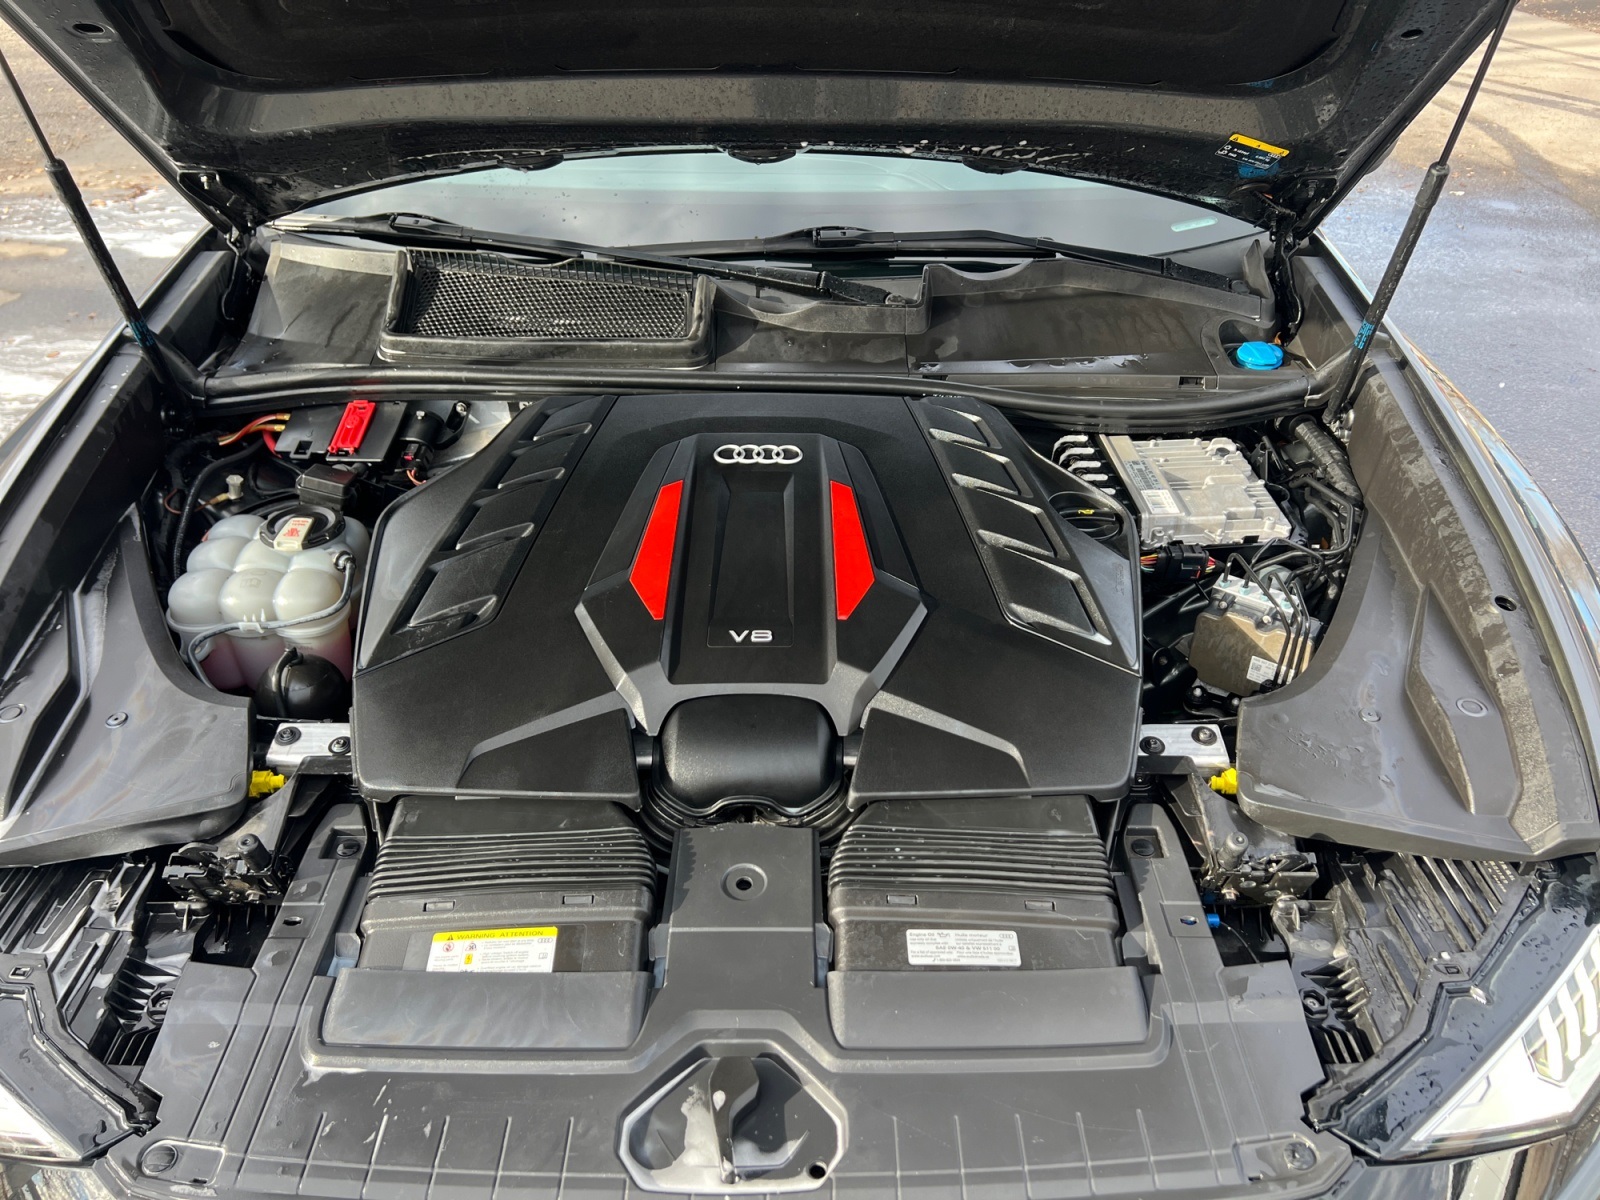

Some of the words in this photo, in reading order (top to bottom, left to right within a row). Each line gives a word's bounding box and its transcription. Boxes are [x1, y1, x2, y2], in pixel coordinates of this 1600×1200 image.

[728, 629, 773, 643] V8
[457, 932, 495, 940] WARNING
[499, 930, 544, 938] ATTENTION
